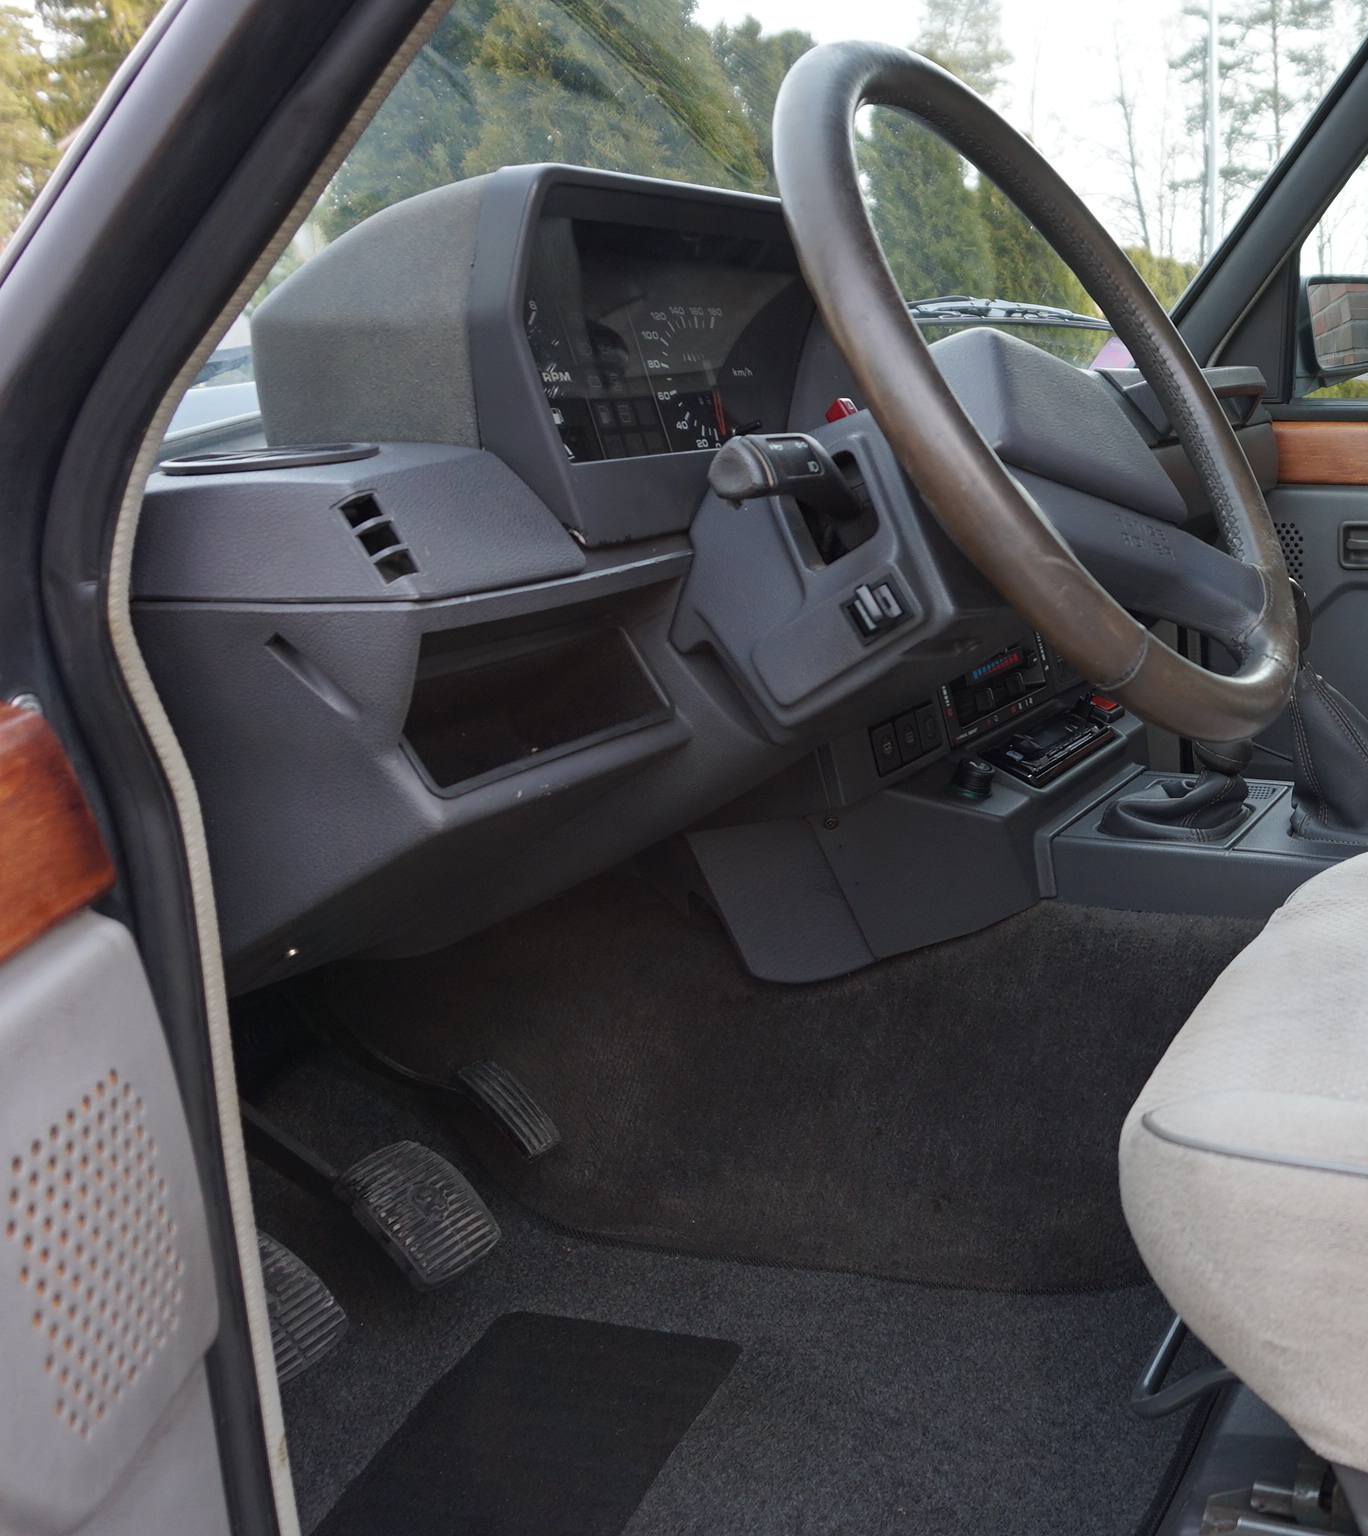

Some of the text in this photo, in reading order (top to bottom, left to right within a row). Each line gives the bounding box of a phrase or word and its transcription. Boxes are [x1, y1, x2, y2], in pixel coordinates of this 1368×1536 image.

[668, 305, 685, 316] 140
[689, 306, 704, 316] 160
[707, 307, 723, 317] 180
[650, 311, 667, 321] 120
[641, 330, 659, 340] 100
[647, 359, 661, 369] 80
[541, 371, 572, 383] RPM
[732, 368, 753, 377] km/h
[657, 391, 670, 401] 60
[676, 420, 689, 430] 40
[696, 438, 709, 448] 20
